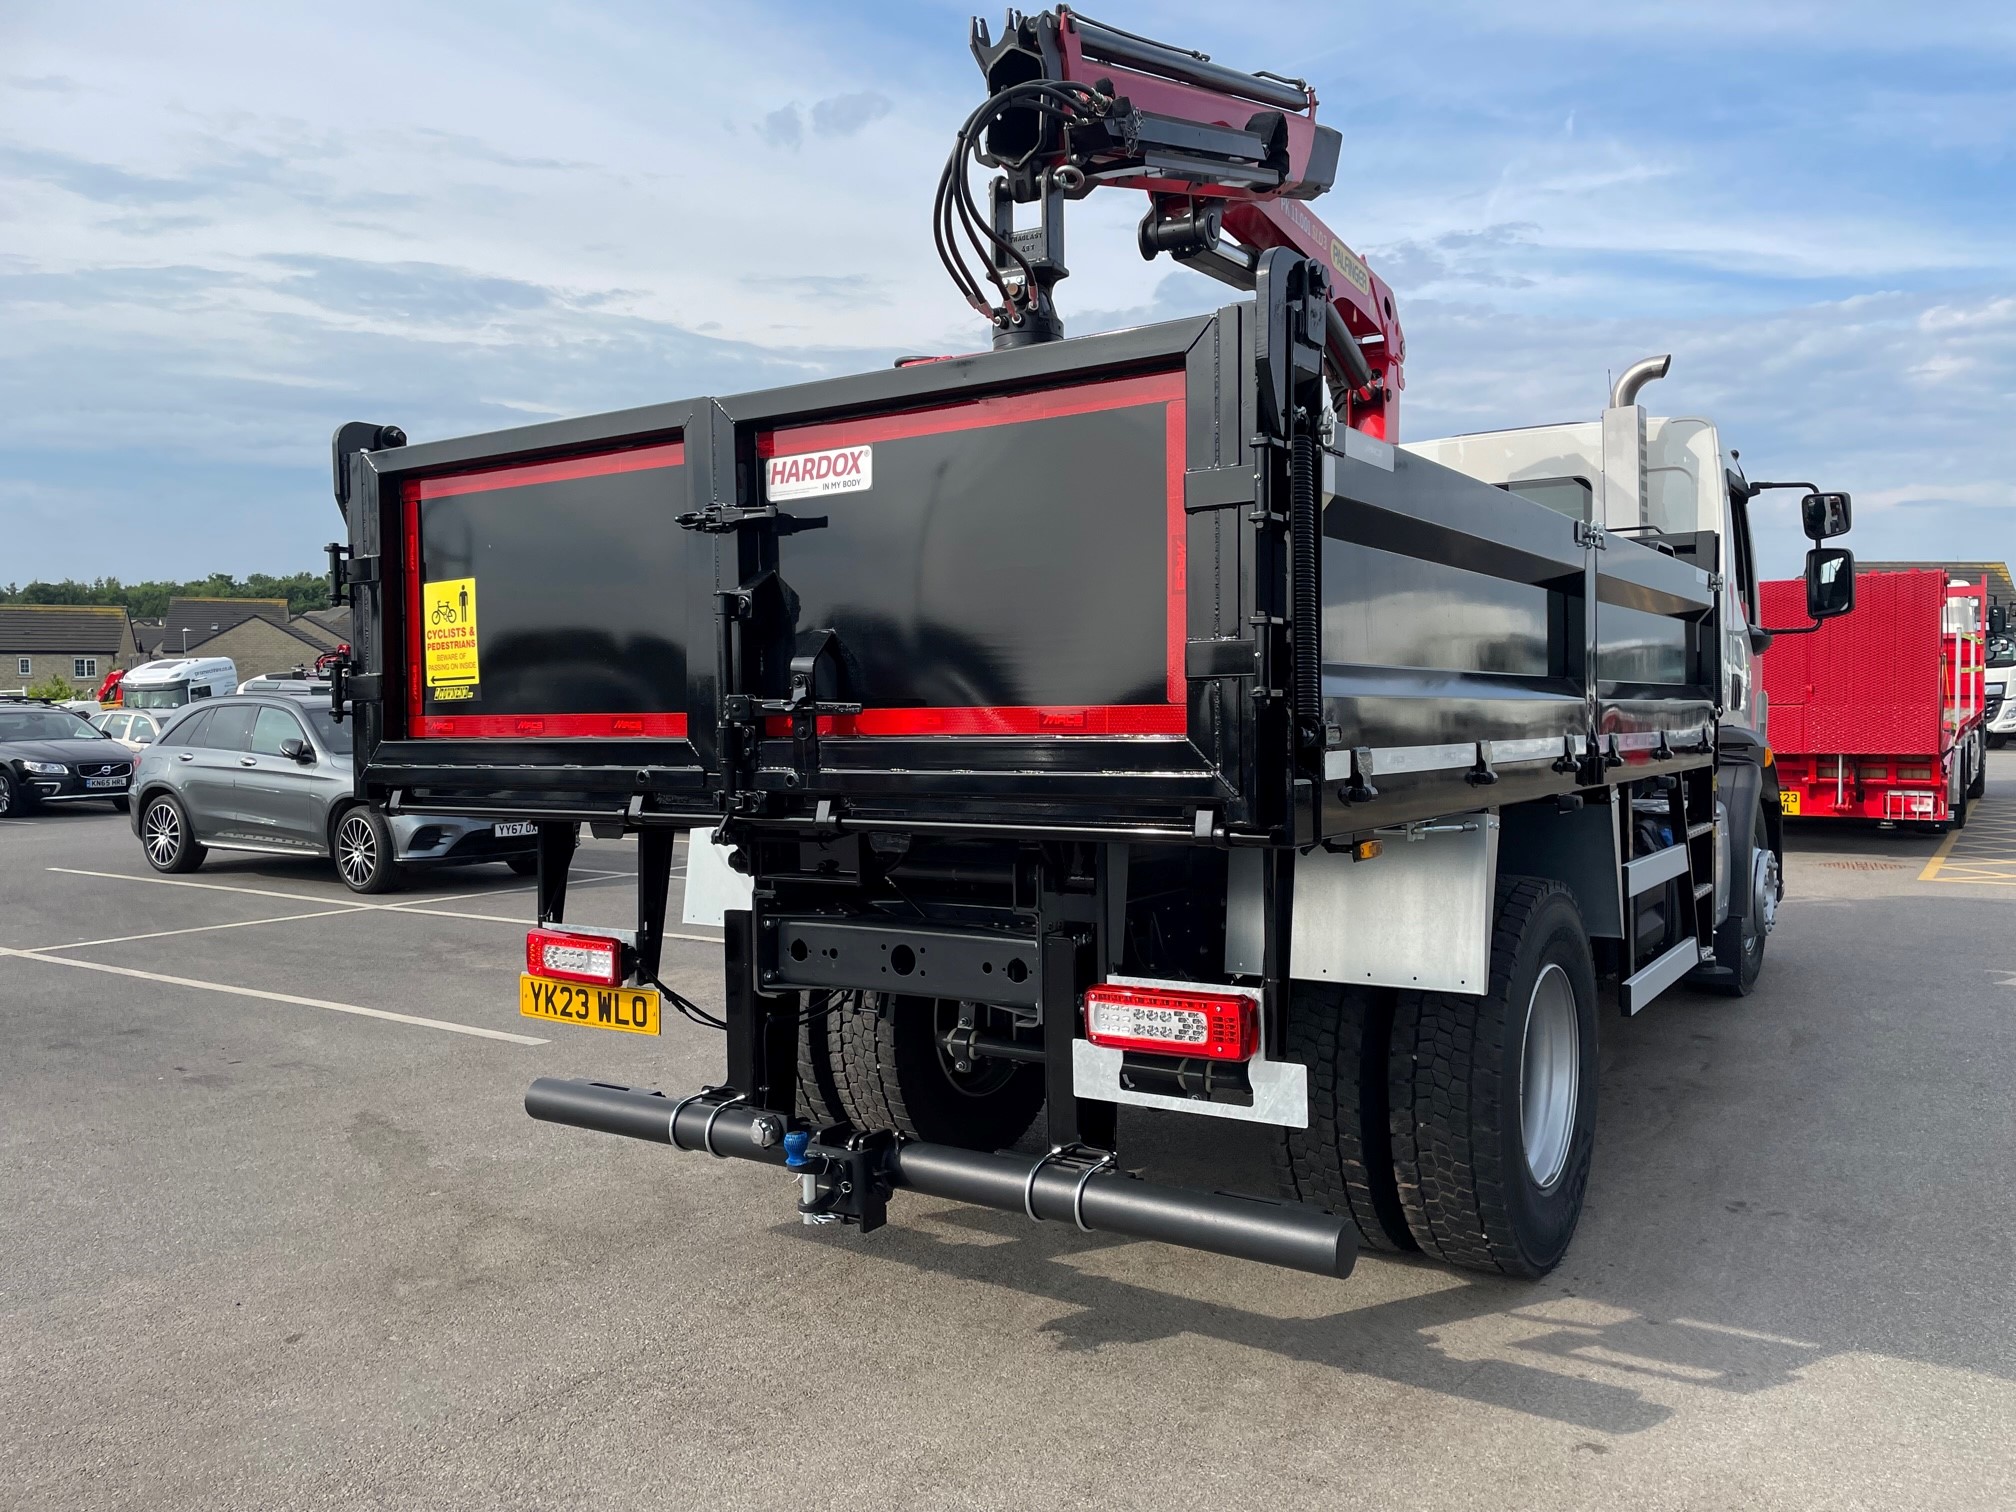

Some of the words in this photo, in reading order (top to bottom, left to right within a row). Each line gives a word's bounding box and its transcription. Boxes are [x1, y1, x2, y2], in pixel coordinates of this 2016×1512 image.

[1333, 244, 1368, 293] PALFINGER
[822, 483, 830, 491] IN
[831, 481, 841, 490] MY
[842, 479, 862, 488] BODY
[426, 627, 467, 640] CYCLISTS
[469, 626, 475, 636] &
[427, 639, 476, 651] PEDESTRIANS
[436, 653, 458, 662] BEWARE
[459, 652, 467, 660] OF
[428, 663, 449, 672] PASSING
[450, 662, 459, 670] ON
[460, 661, 477, 670] INSIDE
[91, 779, 110, 787] KN65
[111, 778, 126, 786] HRL
[499, 823, 524, 836] YY67
[530, 981, 590, 1020] YK23
[597, 991, 648, 1028] WLO
